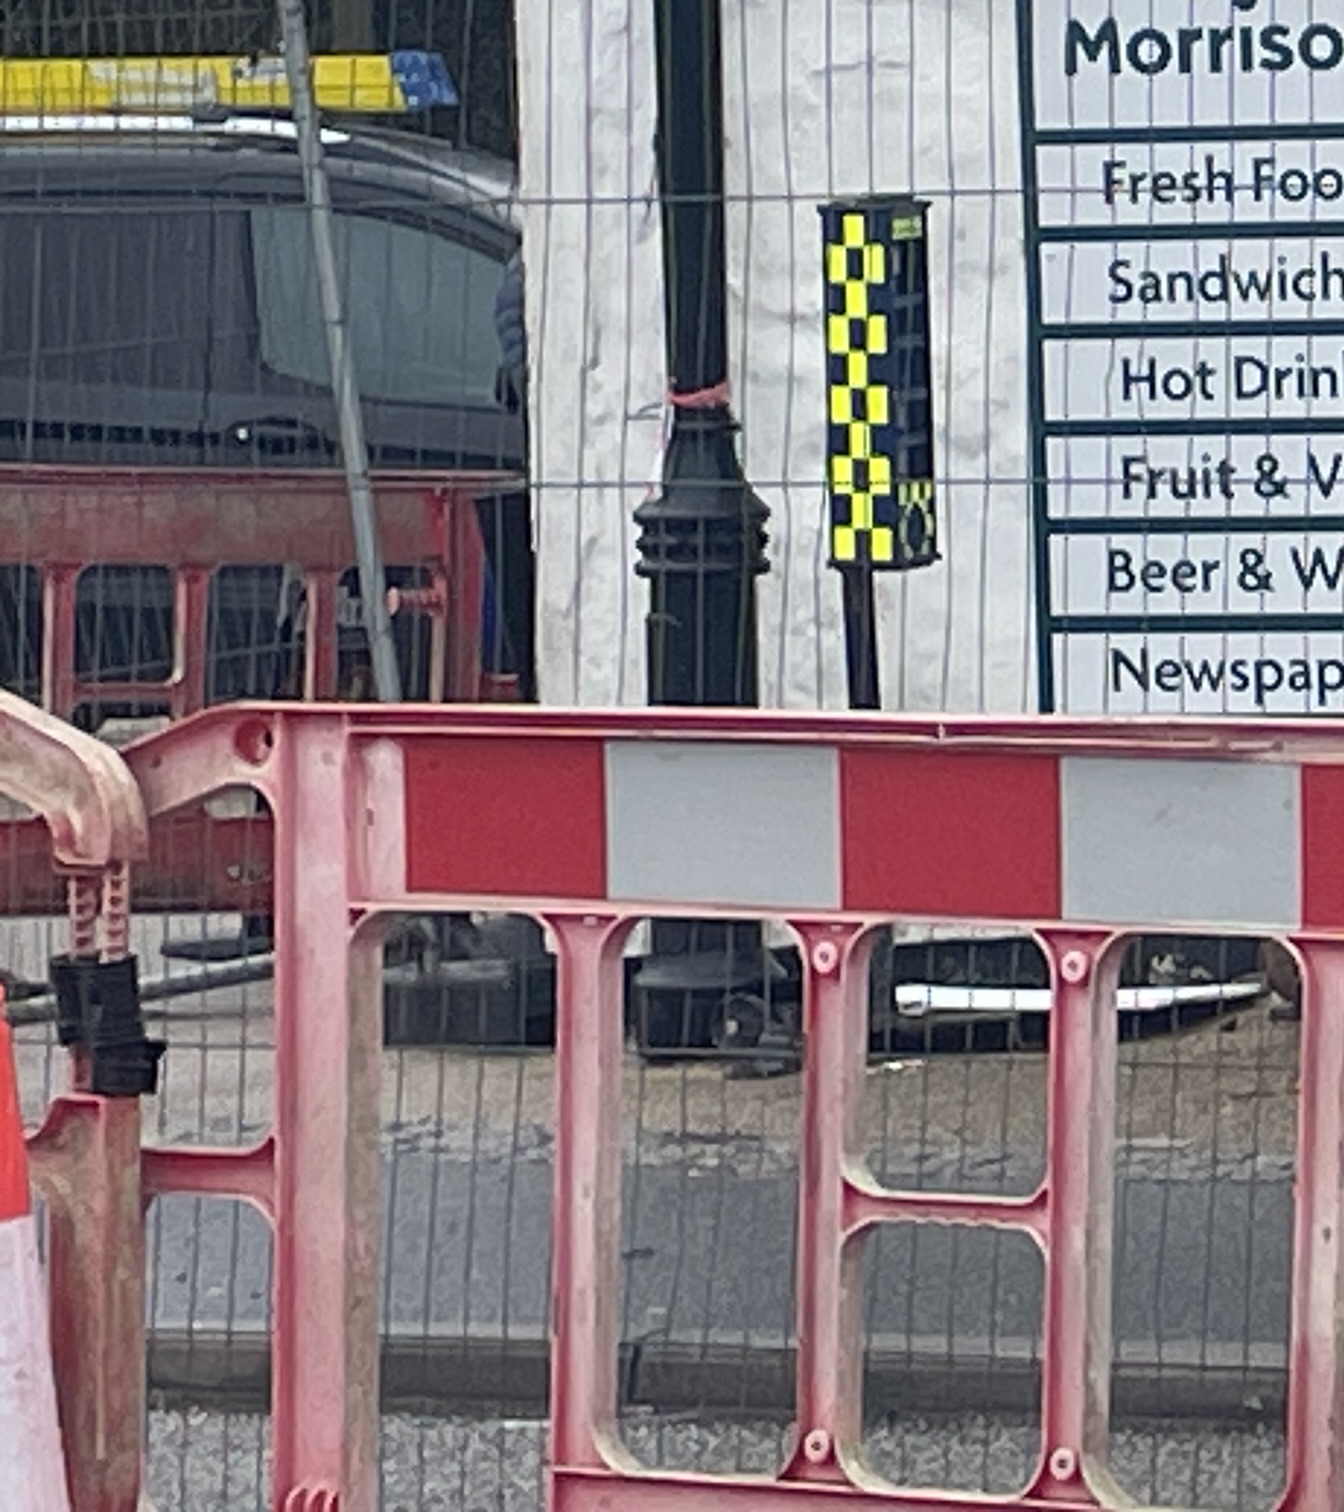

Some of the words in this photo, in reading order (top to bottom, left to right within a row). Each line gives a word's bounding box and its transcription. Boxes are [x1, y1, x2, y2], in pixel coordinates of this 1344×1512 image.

[1103, 154, 1234, 204] Fresh
[1121, 357, 1215, 402] Hot
[1121, 454, 1236, 502] Fruit
[1253, 454, 1288, 500] &
[1107, 550, 1221, 594] Beer
[1237, 550, 1274, 593] &
